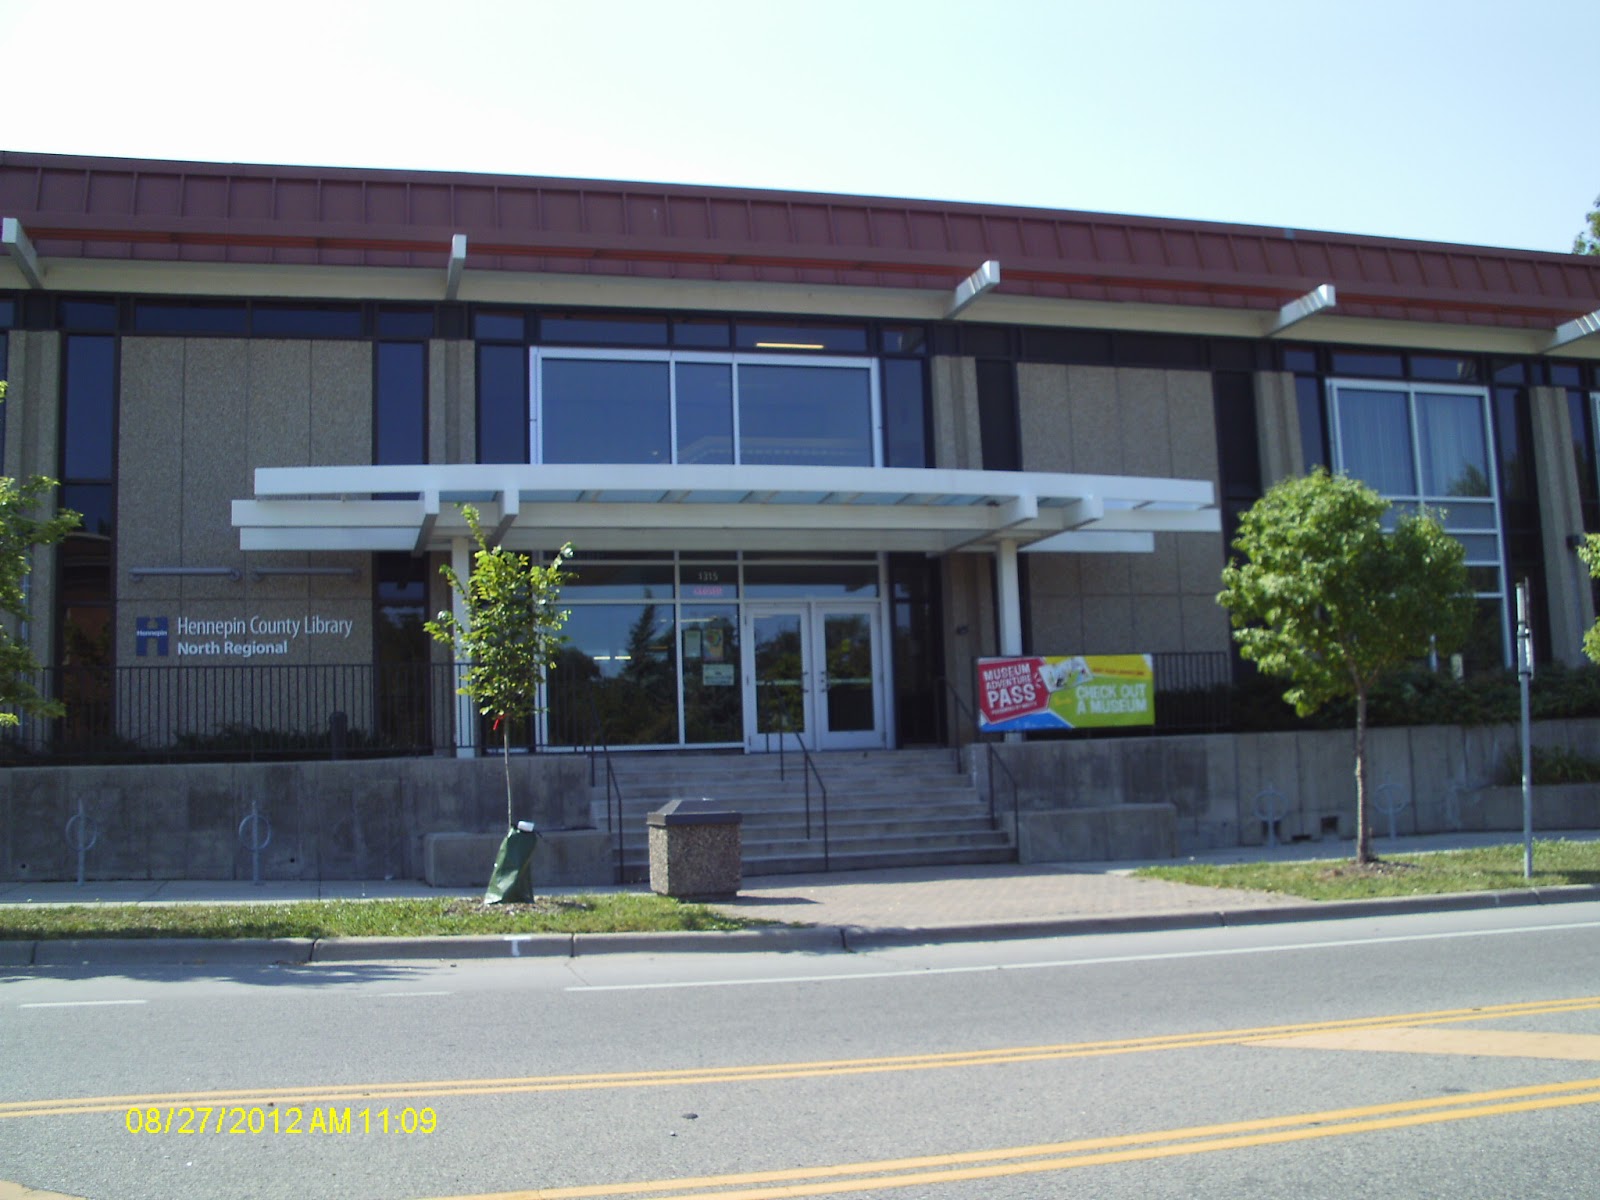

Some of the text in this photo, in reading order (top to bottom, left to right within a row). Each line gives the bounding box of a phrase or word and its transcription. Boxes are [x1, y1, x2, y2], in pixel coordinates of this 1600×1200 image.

[177, 616, 353, 638] Hennepin County Library
[177, 640, 288, 657] North Regional
[983, 663, 1032, 681] MUSEUM
[986, 674, 1033, 691] ADVENTURE
[987, 683, 1037, 709] PASS
[1076, 683, 1147, 700] CHECK OUT
[1076, 701, 1087, 715] A
[1090, 699, 1148, 714] MUSEUM
